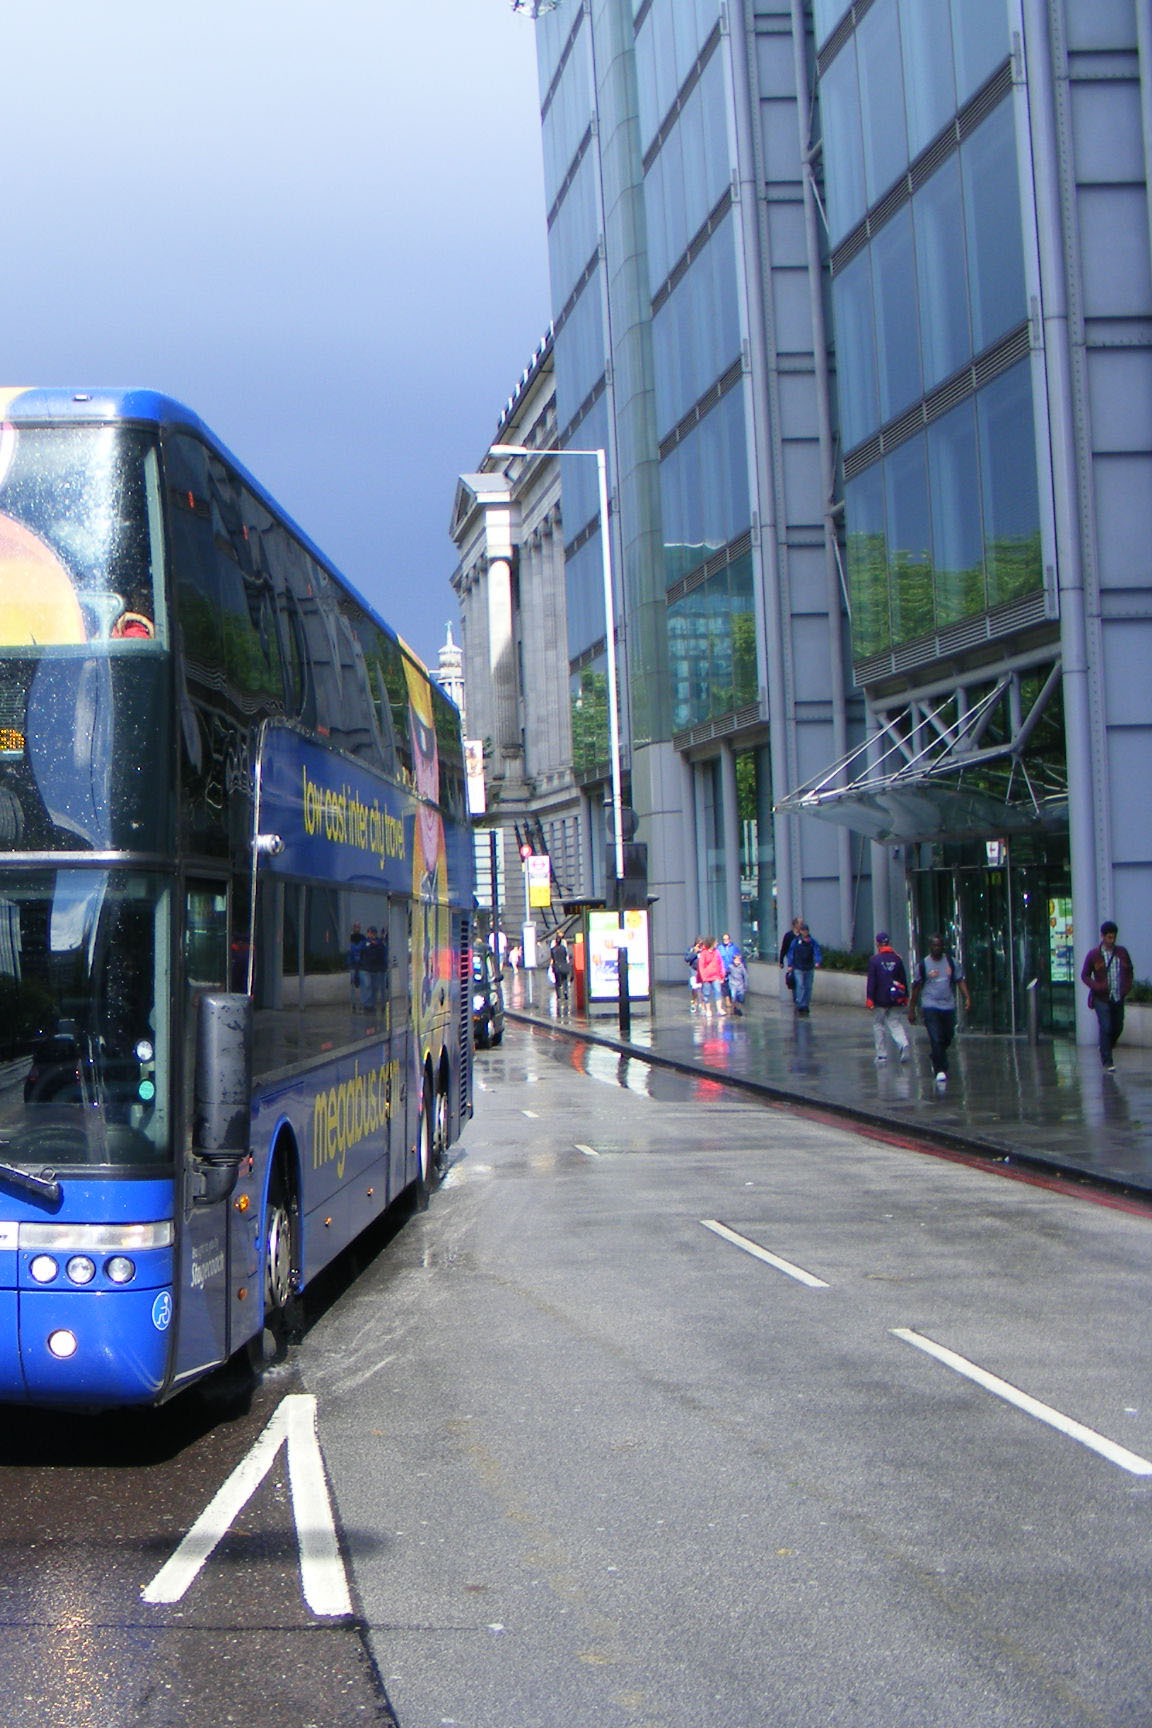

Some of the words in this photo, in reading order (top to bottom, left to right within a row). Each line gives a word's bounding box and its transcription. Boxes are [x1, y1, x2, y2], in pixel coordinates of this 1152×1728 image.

[303, 764, 322, 836] low
[325, 783, 348, 844] cost
[348, 785, 369, 850] inter
[369, 797, 386, 871] city
[384, 803, 406, 861] travel
